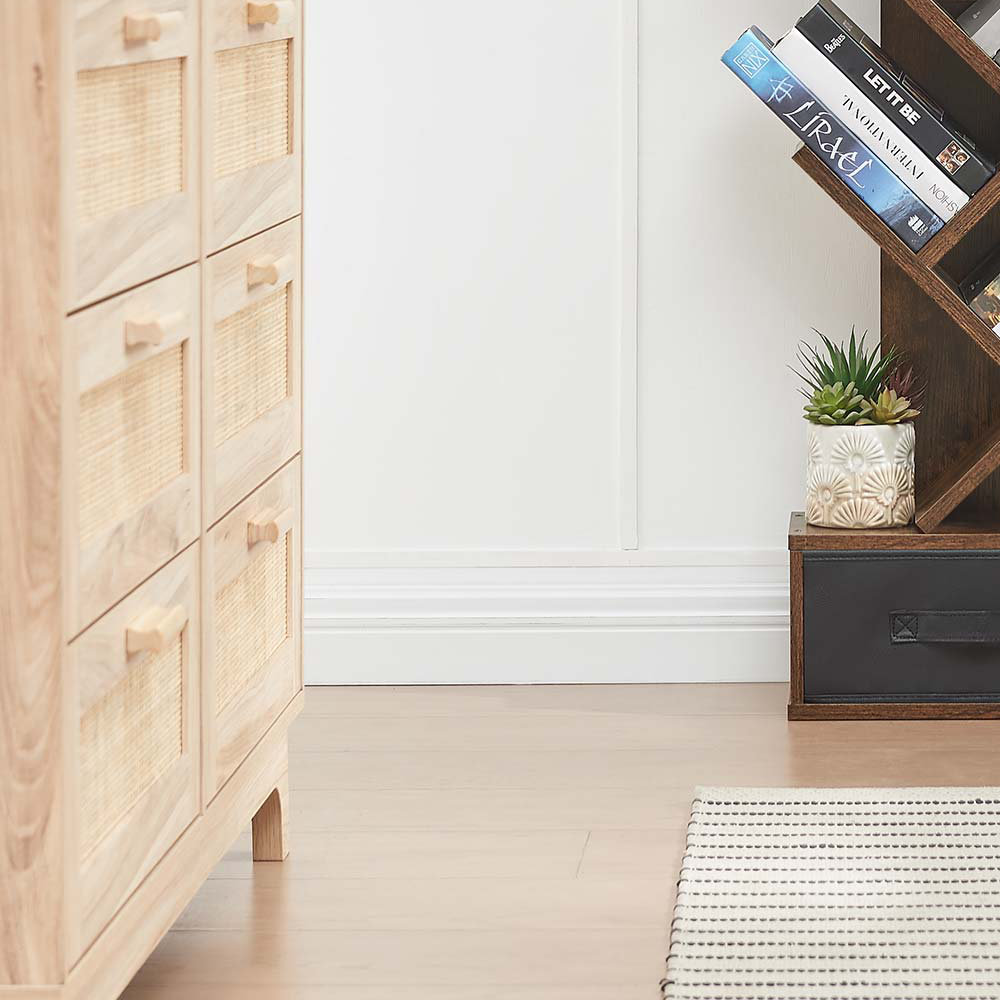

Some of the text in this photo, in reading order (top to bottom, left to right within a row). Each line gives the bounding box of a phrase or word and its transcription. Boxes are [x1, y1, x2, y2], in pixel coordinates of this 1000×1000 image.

[862, 68, 922, 125] LET IT BE
[842, 94, 923, 179] INTERNATIONAL
